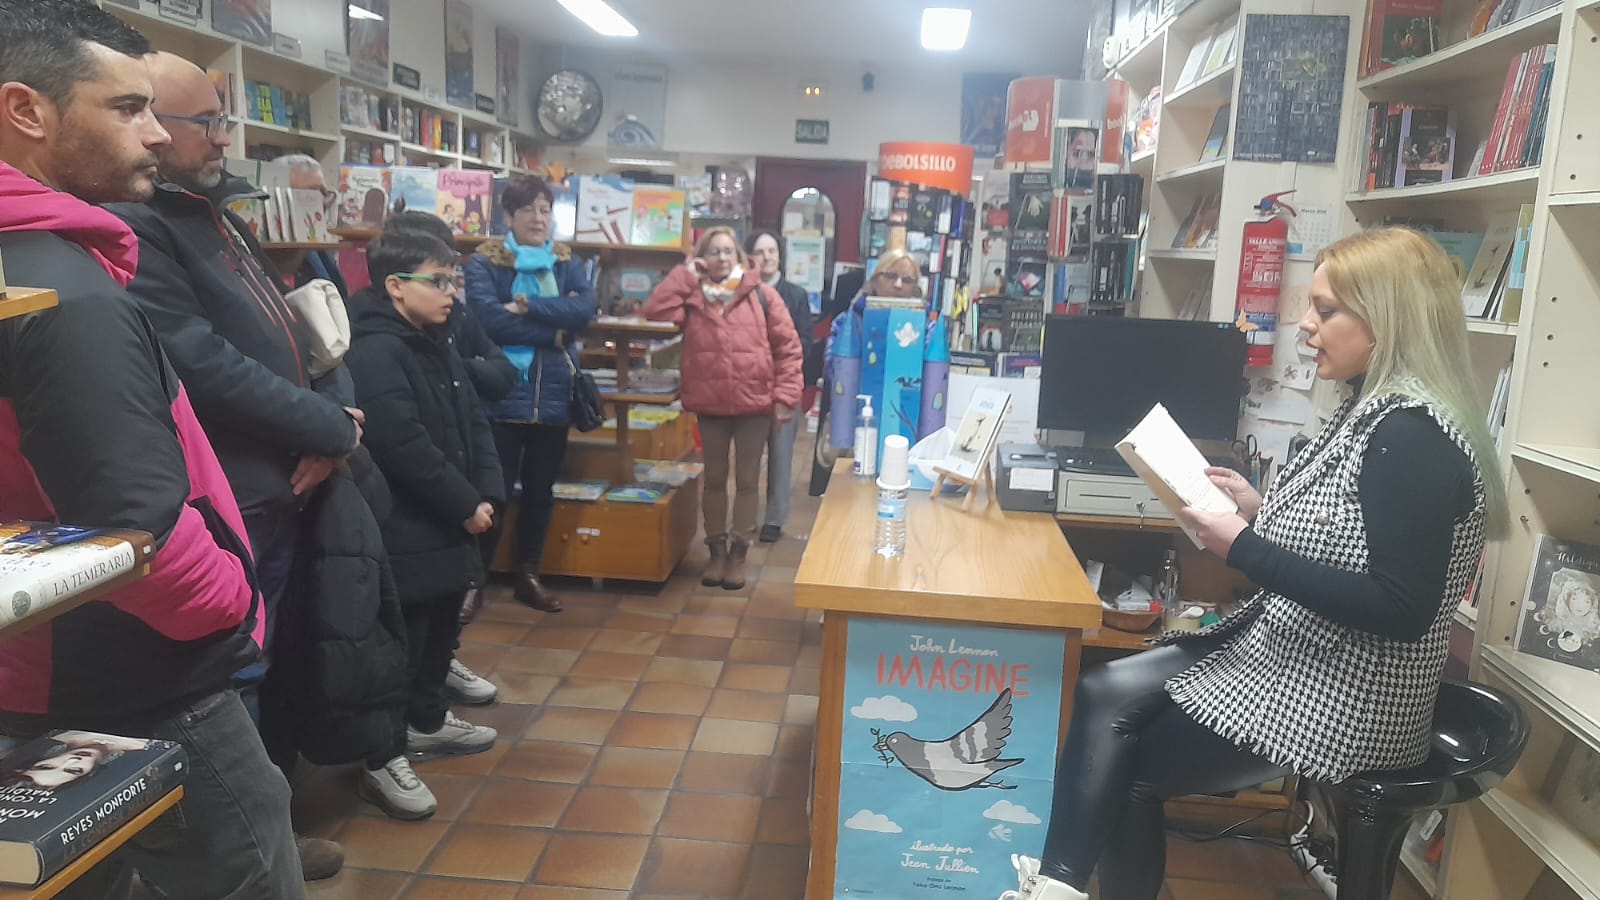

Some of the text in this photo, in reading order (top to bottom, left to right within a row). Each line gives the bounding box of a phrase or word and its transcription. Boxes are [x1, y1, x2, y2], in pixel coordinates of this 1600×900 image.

[798, 123, 827, 138] SALIDA
[53, 551, 133, 596] LA TEMERARIA
[910, 634, 999, 657] John Lennon
[876, 652, 1031, 697] IMAGINE
[60, 815, 94, 845] REYES
[94, 777, 147, 822] MONFORTE
[901, 852, 980, 873] Jean Jullien
